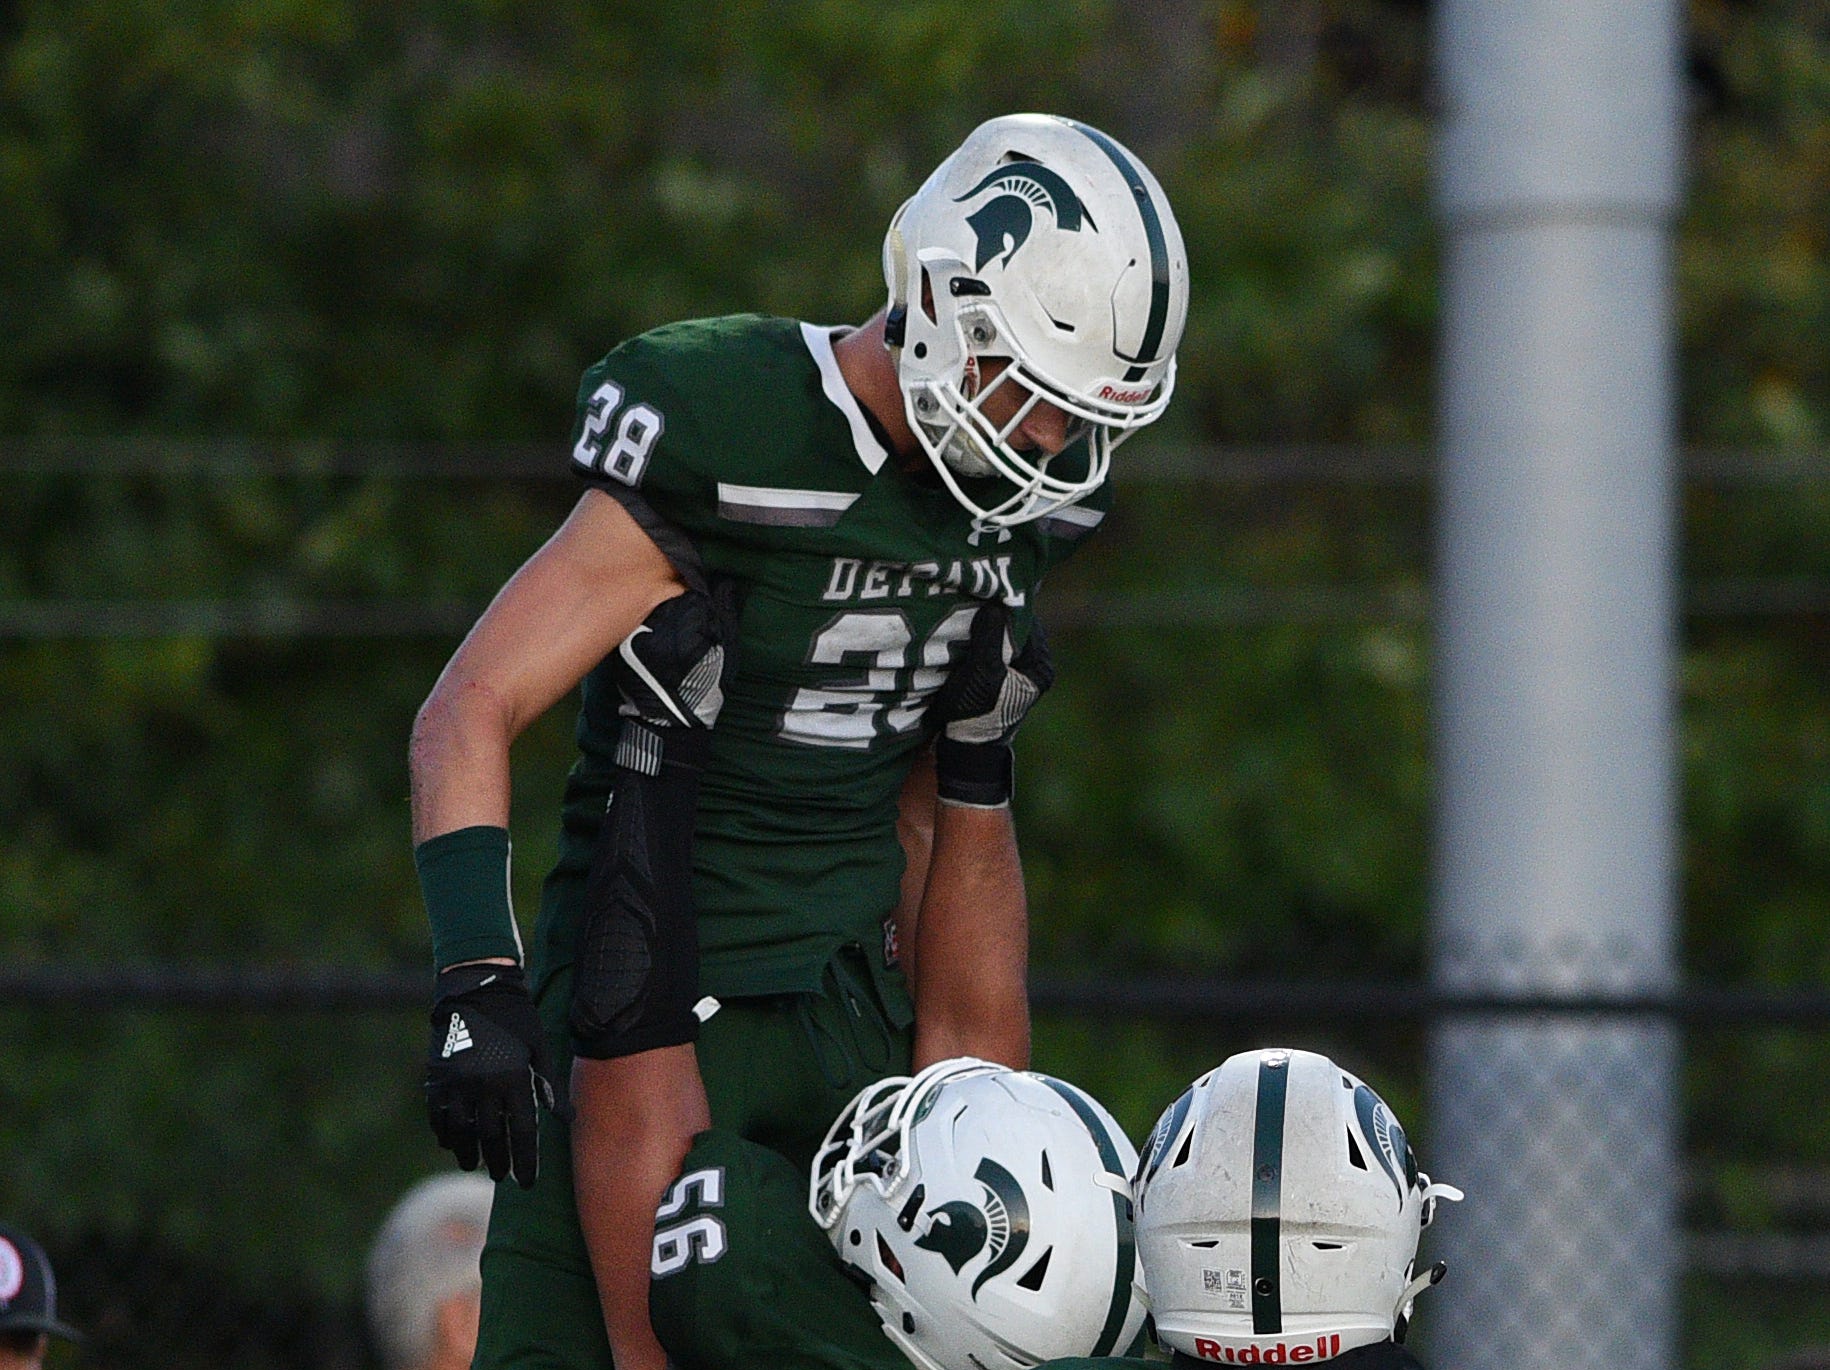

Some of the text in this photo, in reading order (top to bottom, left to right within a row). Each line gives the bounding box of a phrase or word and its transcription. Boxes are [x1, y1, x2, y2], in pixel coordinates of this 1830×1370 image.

[572, 379, 664, 487] 28
[652, 1167, 727, 1278] 56
[1195, 1334, 1340, 1366] Riddell
